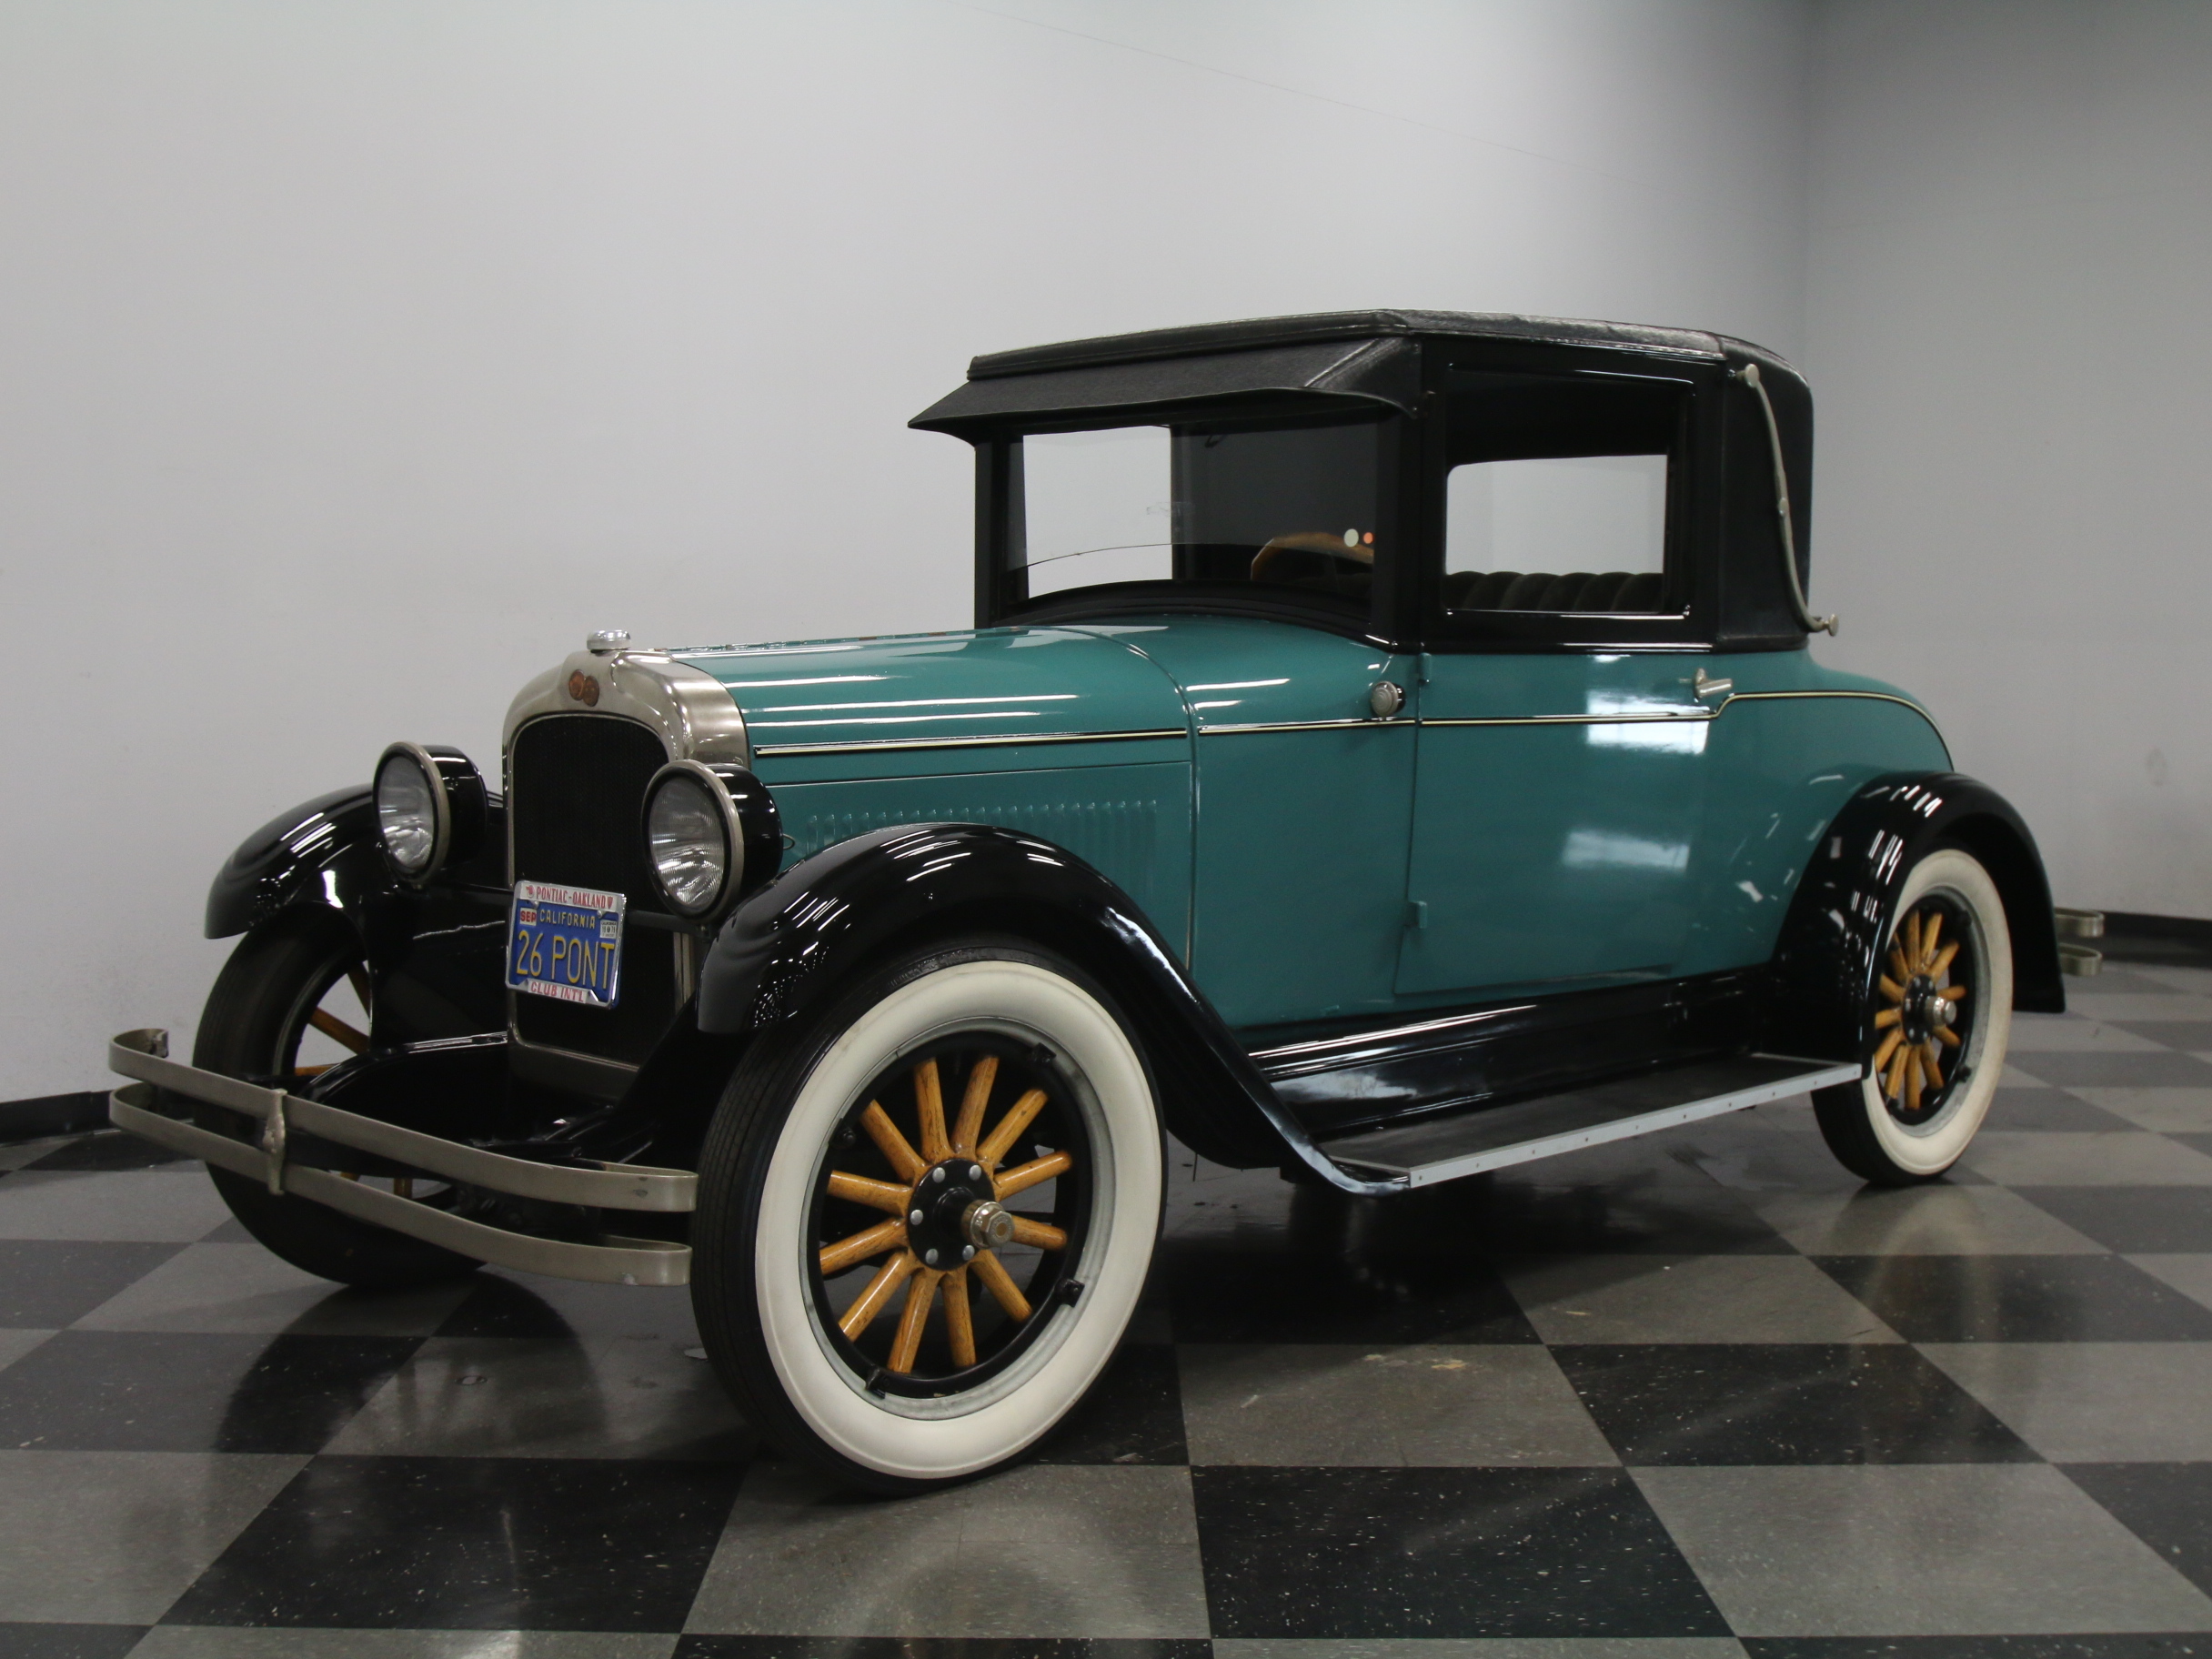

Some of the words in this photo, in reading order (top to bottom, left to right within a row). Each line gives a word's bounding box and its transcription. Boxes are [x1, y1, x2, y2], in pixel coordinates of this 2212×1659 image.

[520, 910, 537, 922] SEP
[540, 909, 596, 929] CALIFORNIA
[516, 930, 544, 977] 26
[551, 935, 615, 990] PONT
[530, 981, 558, 997] CLUB
